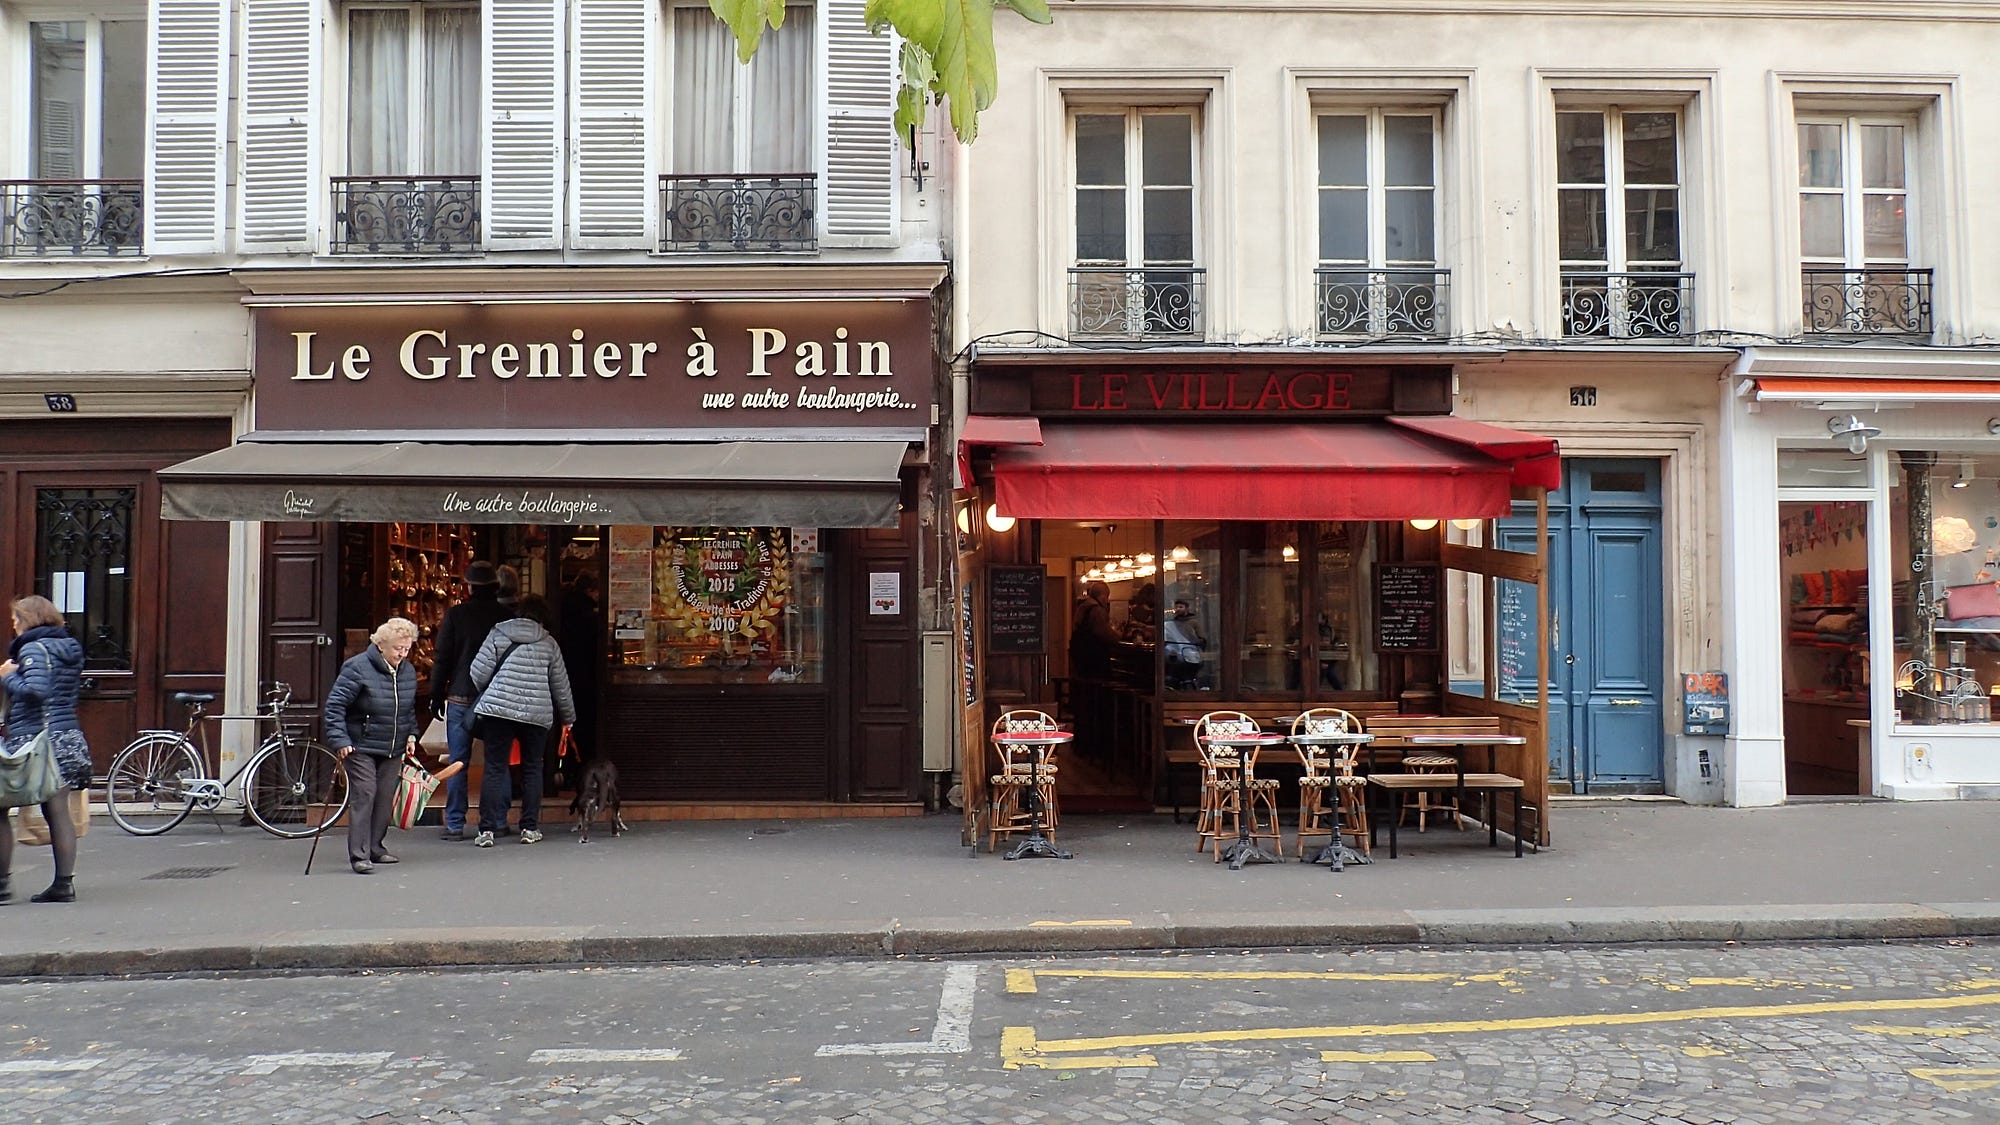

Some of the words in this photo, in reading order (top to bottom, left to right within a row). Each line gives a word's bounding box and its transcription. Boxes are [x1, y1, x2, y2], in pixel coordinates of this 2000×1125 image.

[290, 332, 371, 381] Le
[399, 328, 657, 380] Grenier
[686, 327, 718, 377] à
[746, 327, 893, 377] Pain
[702, 391, 735, 409] une
[741, 387, 790, 409] autre
[797, 386, 917, 413] boulangerie...
[1070, 373, 1130, 410] LE
[1142, 373, 1353, 410] VILLAGE
[1571, 388, 1596, 406] 36
[49, 396, 72, 410] 38
[443, 491, 472, 512] Une
[475, 493, 513, 512] autre
[518, 491, 612, 523] boulangerie...
[757, 541, 770, 563] Paris
[760, 566, 771, 577] de
[708, 577, 735, 592] 2015
[734, 580, 768, 611] Tradition
[686, 593, 724, 615] Baguette
[708, 617, 735, 632] 2010
